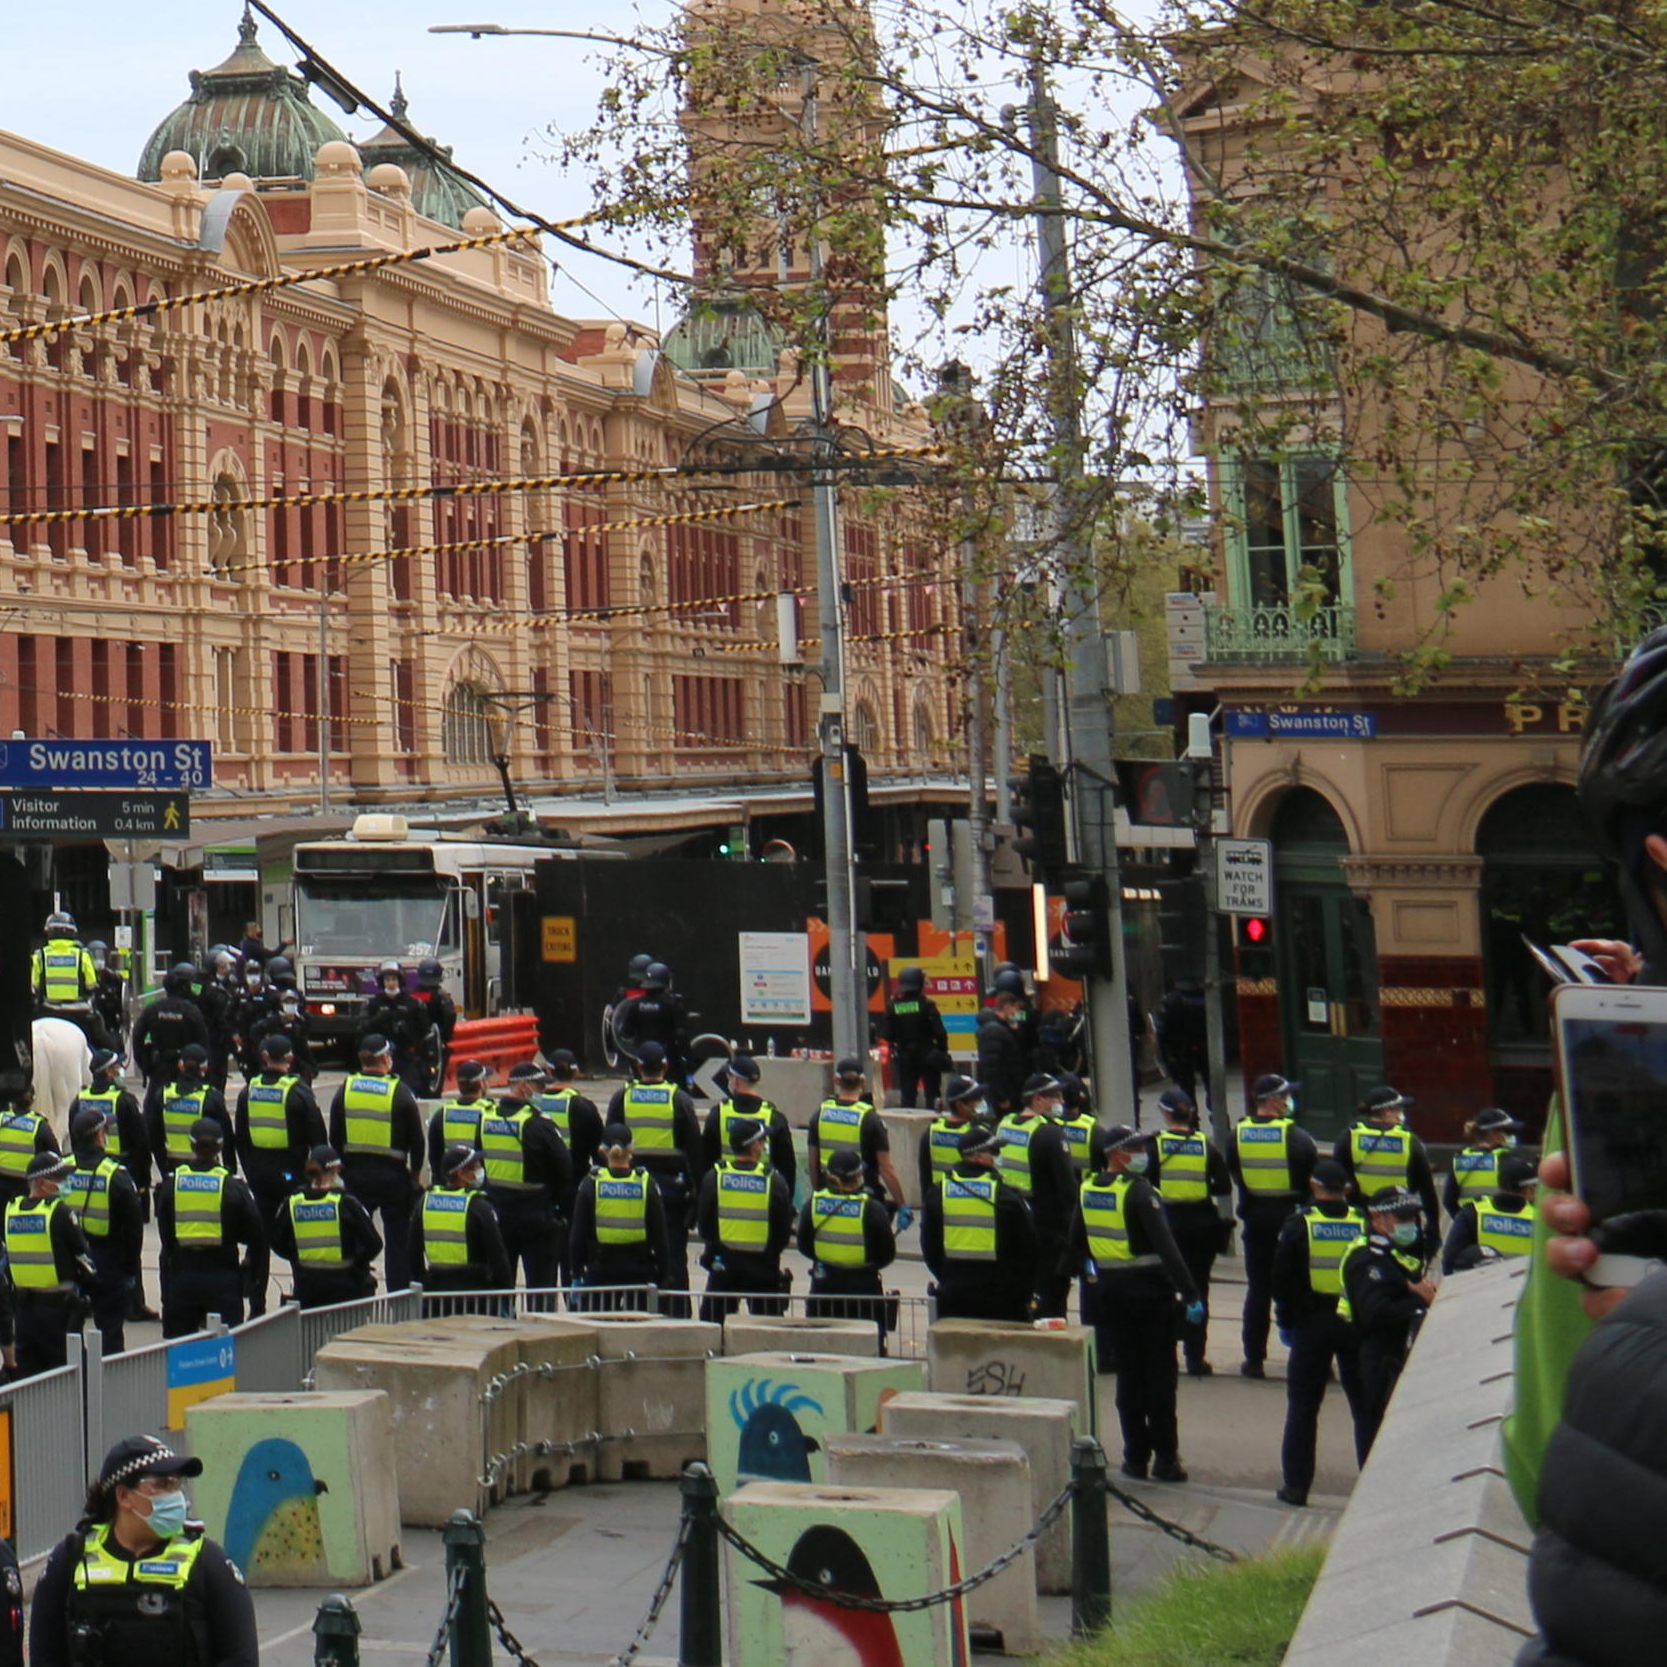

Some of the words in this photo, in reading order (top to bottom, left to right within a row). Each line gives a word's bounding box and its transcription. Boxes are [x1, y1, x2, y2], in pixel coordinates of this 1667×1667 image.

[1269, 714, 1349, 730] Swanston
[1353, 715, 1370, 730] St
[29, 743, 166, 771] Swanston
[174, 743, 204, 771] St
[137, 771, 157, 785] 24
[180, 771, 204, 785] 40
[12, 798, 60, 813] Visitor
[122, 802, 129, 814] 5
[133, 802, 155, 814] min
[12, 816, 97, 831] information
[114, 819, 133, 831] 0.4
[136, 818, 155, 831] km
[1224, 870, 1263, 883] WATCH
[1232, 884, 1255, 895] FOR
[1225, 895, 1263, 908] TRAMS
[355, 1080, 386, 1093] Police
[633, 1089, 667, 1102] Police
[824, 1110, 858, 1123] Police
[1242, 1128, 1281, 1142] Police
[181, 1176, 218, 1190] Police
[724, 1174, 765, 1191] Police
[602, 1183, 641, 1198] Police
[429, 1195, 466, 1210] Police
[296, 1204, 335, 1220] Police
[11, 1216, 45, 1233] Police
[1487, 1216, 1530, 1235] Police
[1317, 1224, 1359, 1240] Police
